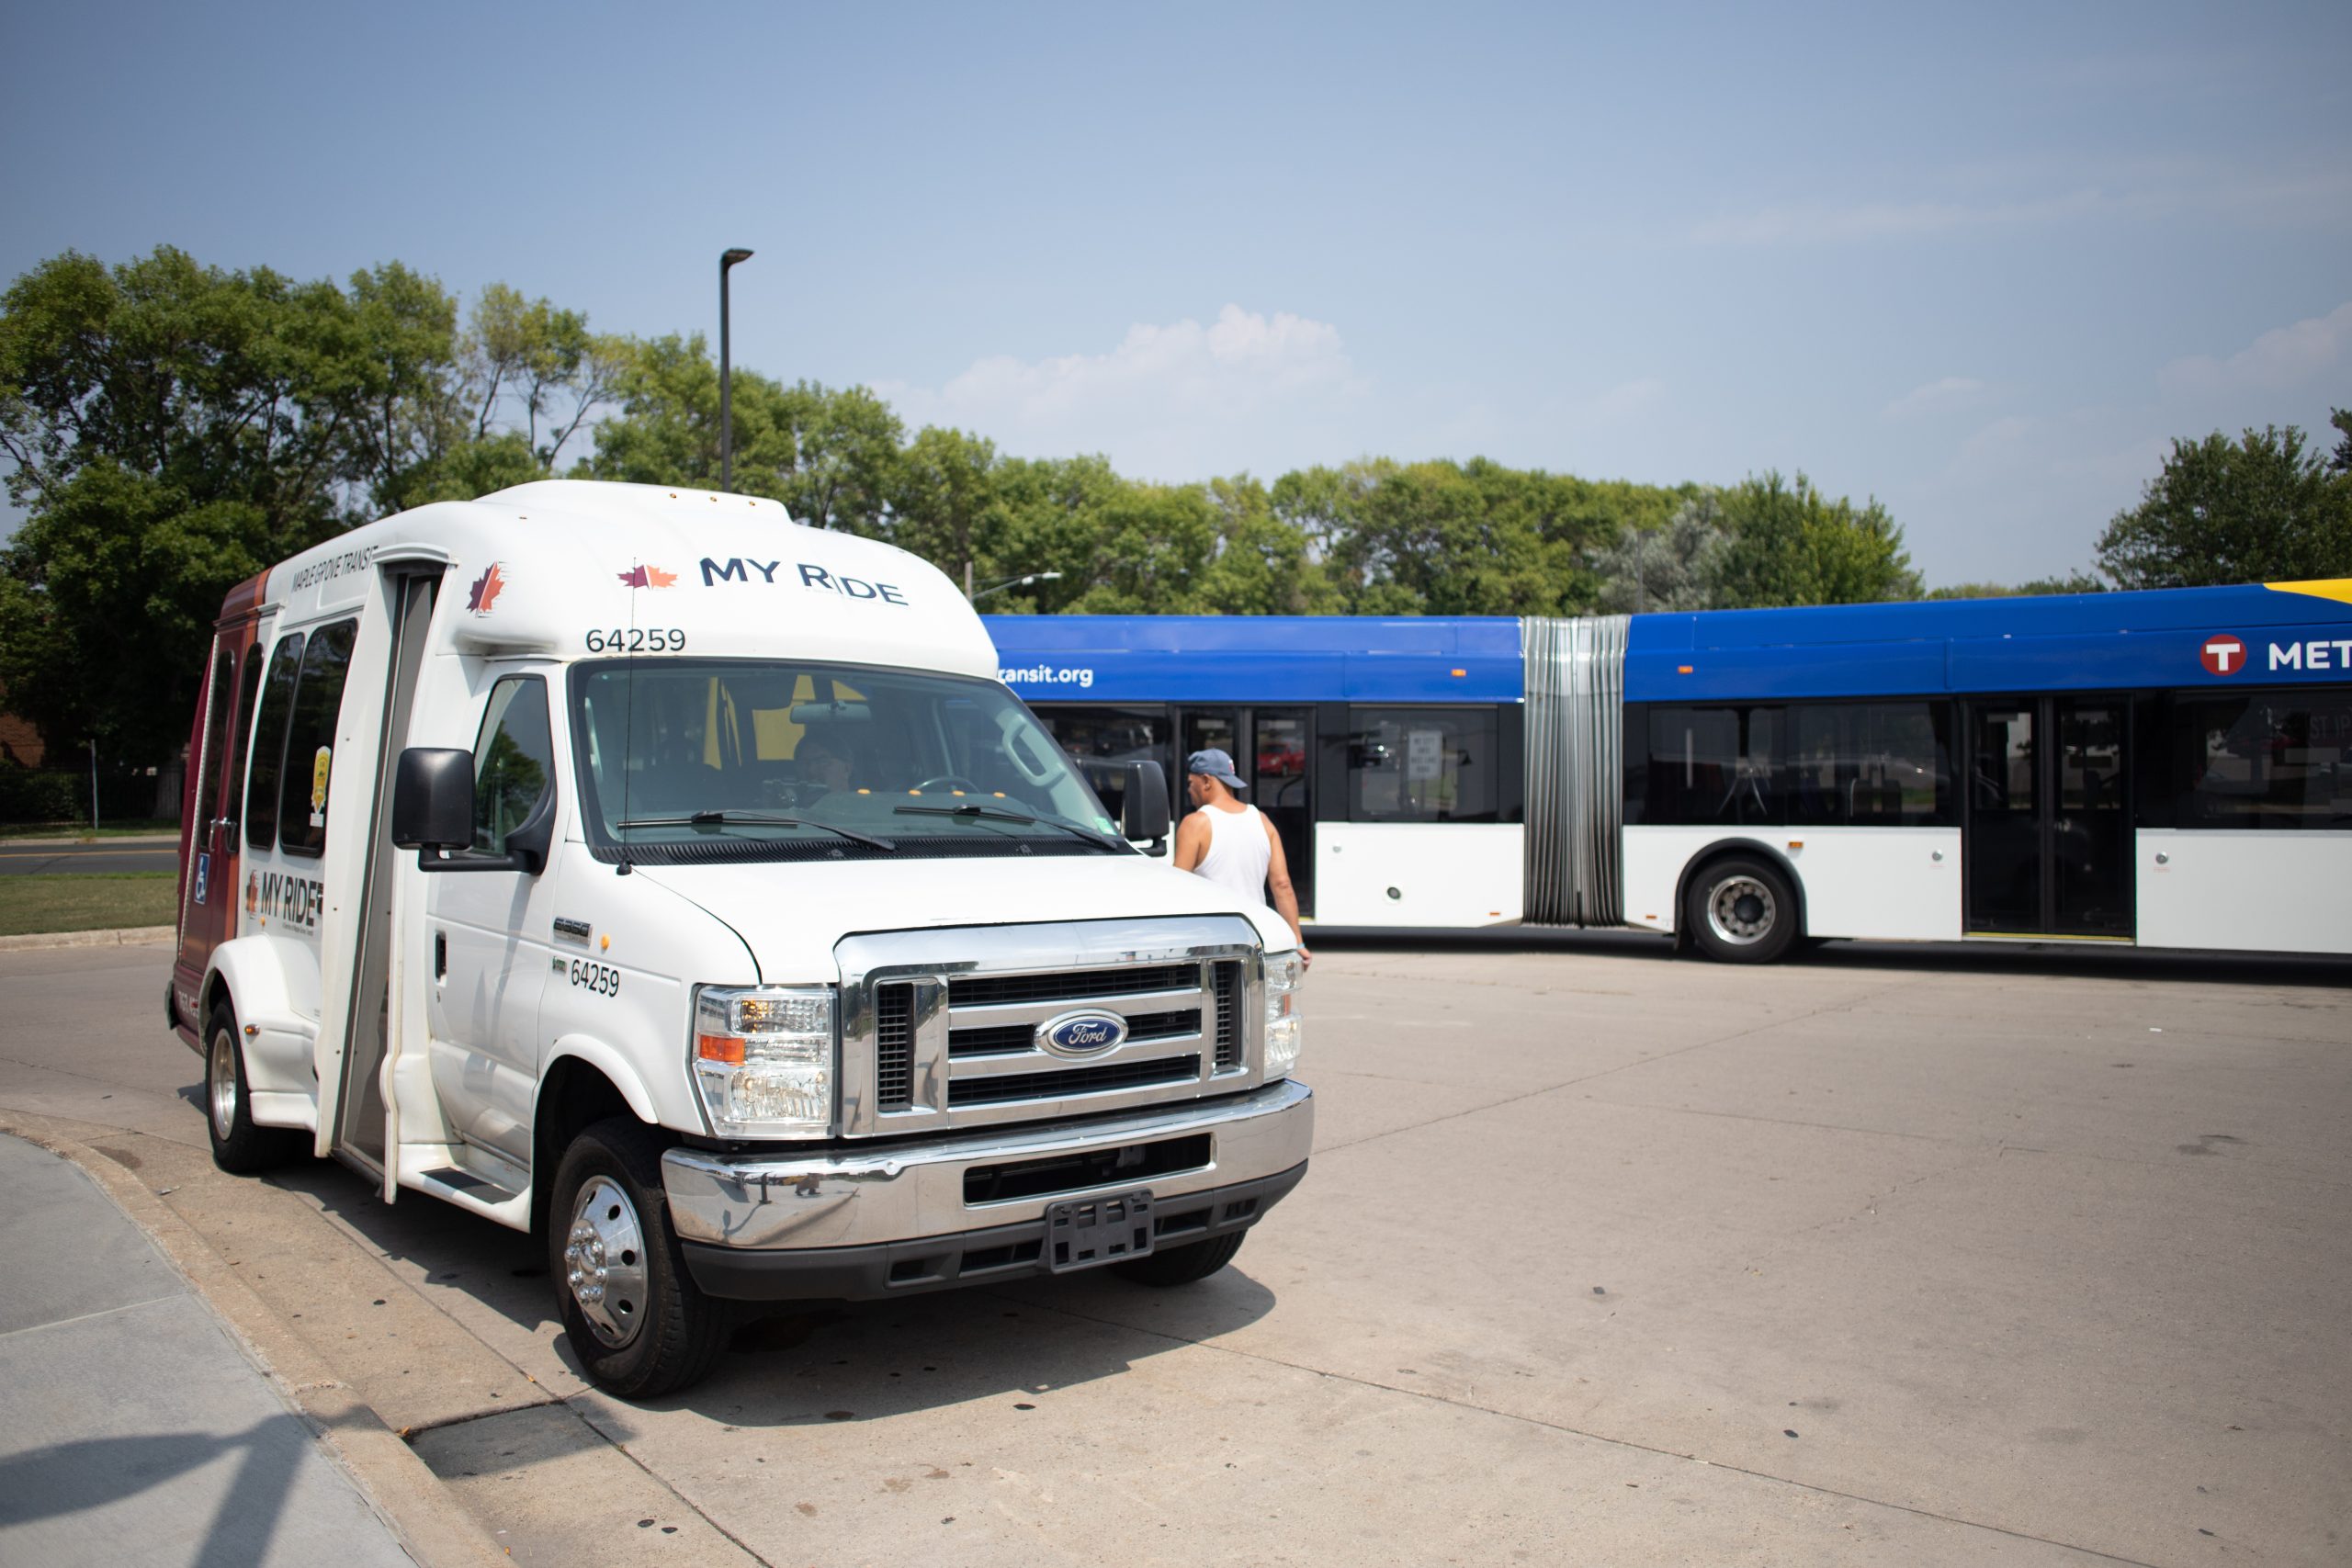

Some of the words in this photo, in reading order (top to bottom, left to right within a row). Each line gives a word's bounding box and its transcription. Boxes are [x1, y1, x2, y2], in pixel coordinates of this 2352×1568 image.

[291, 564, 316, 592] MAPLE
[314, 555, 342, 583] GROVE
[699, 557, 781, 587] MY
[797, 563, 910, 606] RIDE
[585, 627, 686, 653] 64259
[2268, 640, 2352, 671] MET
[260, 871, 283, 917] MY
[283, 875, 317, 927] RIDE
[571, 958, 620, 998] 64259
[1068, 1021, 1107, 1045] Ford
